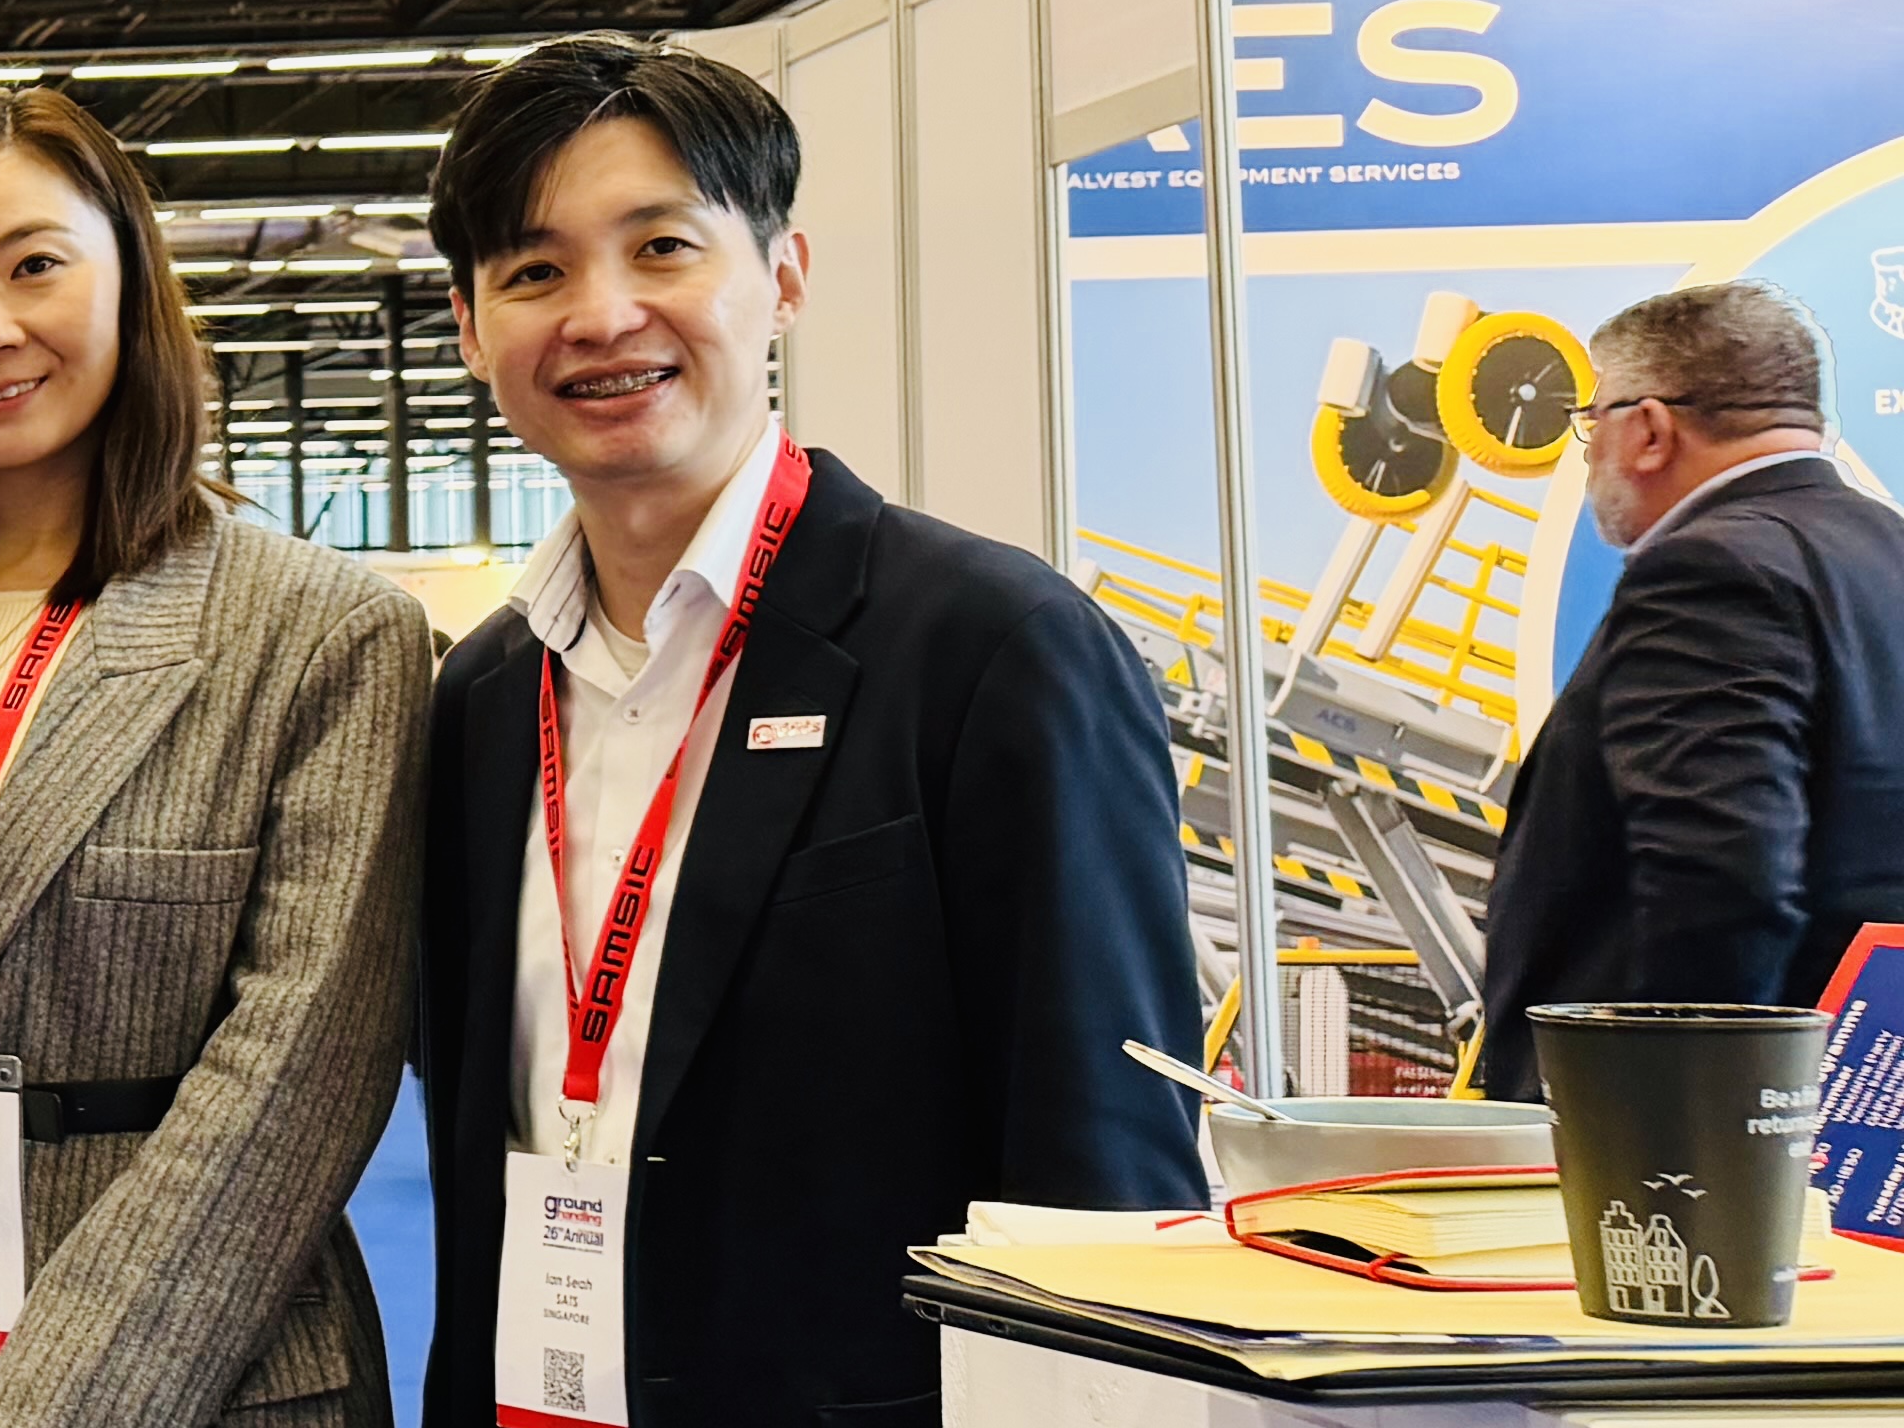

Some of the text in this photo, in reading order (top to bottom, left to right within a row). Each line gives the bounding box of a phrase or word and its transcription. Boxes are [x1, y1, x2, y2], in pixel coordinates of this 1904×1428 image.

[1067, 161, 1461, 189] ALVEST EQPMENT SERVICES
[2, 603, 73, 710] SAMS
[581, 844, 657, 1043] SAMSIC
[544, 1195, 603, 1220] ground
